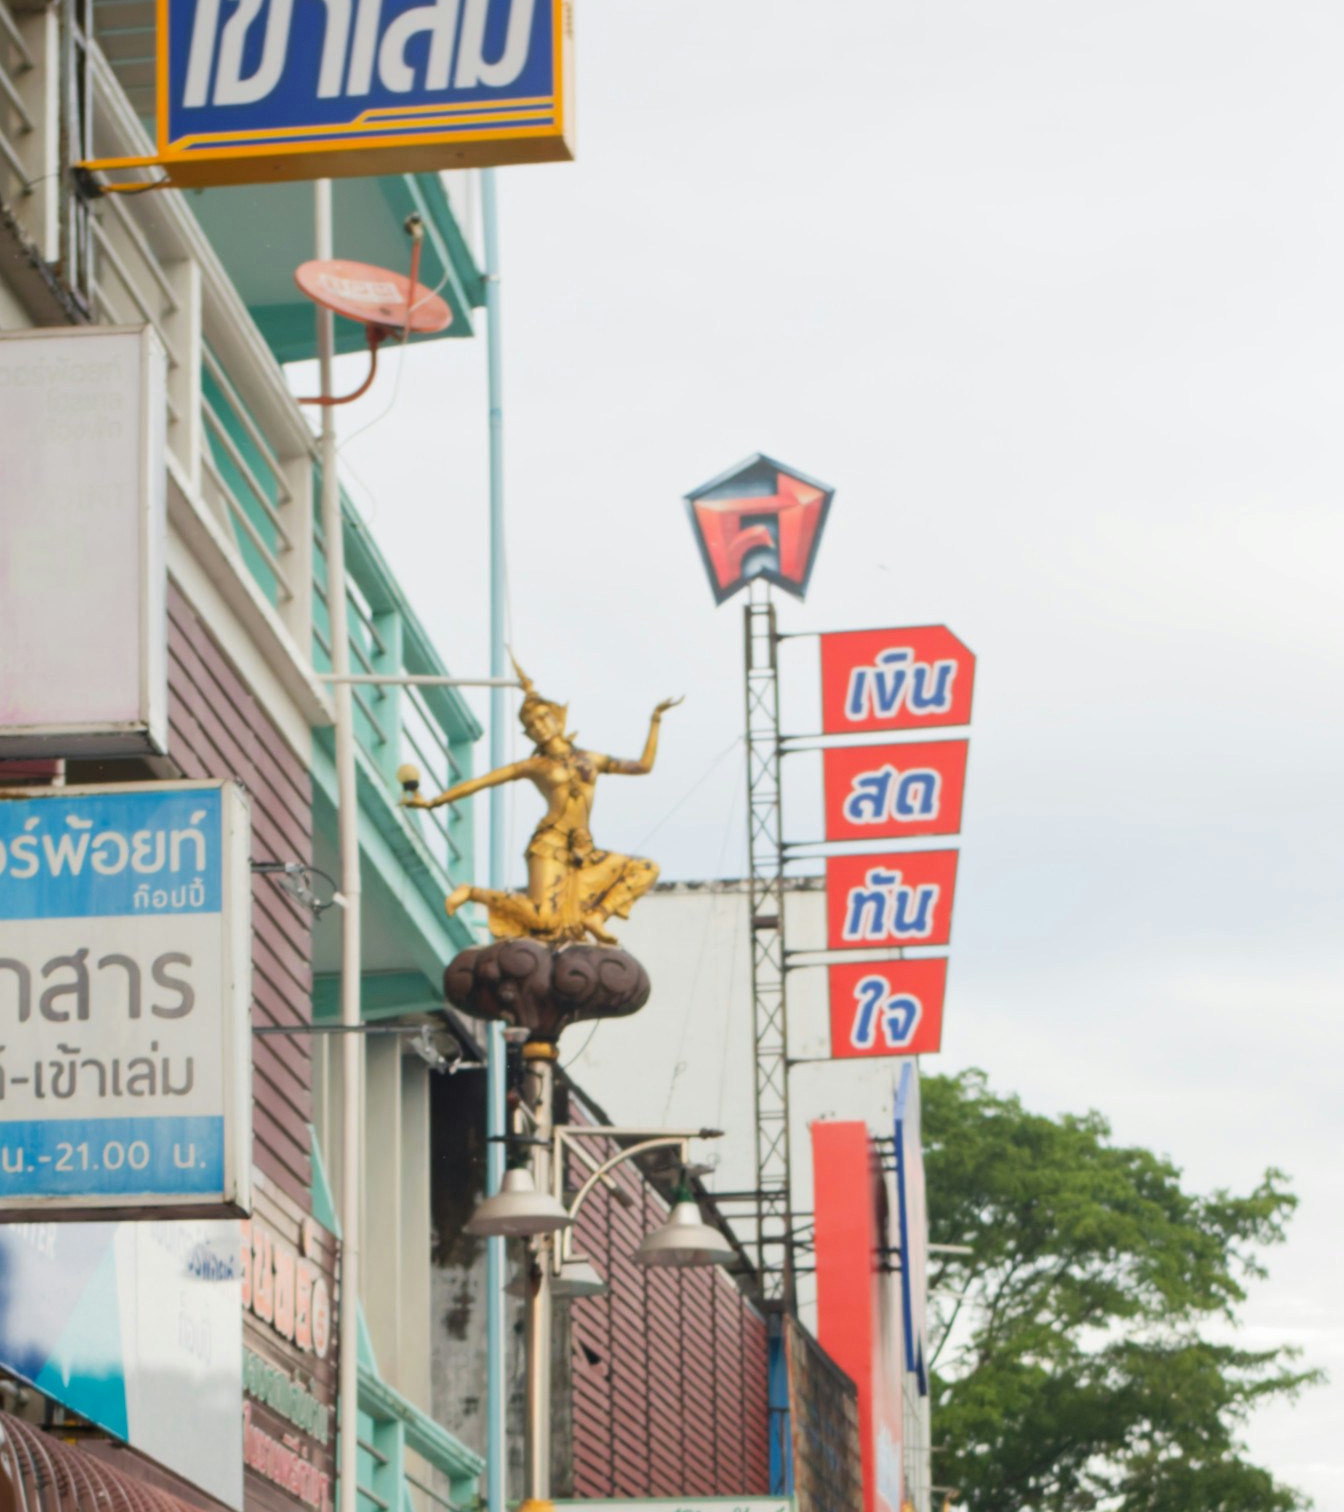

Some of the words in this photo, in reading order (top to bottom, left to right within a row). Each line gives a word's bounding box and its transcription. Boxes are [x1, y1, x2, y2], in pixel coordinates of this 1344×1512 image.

[848, 652, 953, 718] เงิน
[846, 765, 938, 821] สด
[133, 876, 206, 910] ก๊อปปี้
[845, 870, 934, 938] ทัน
[853, 978, 920, 1046] ใจ
[172, 1142, 207, 1170] น.
